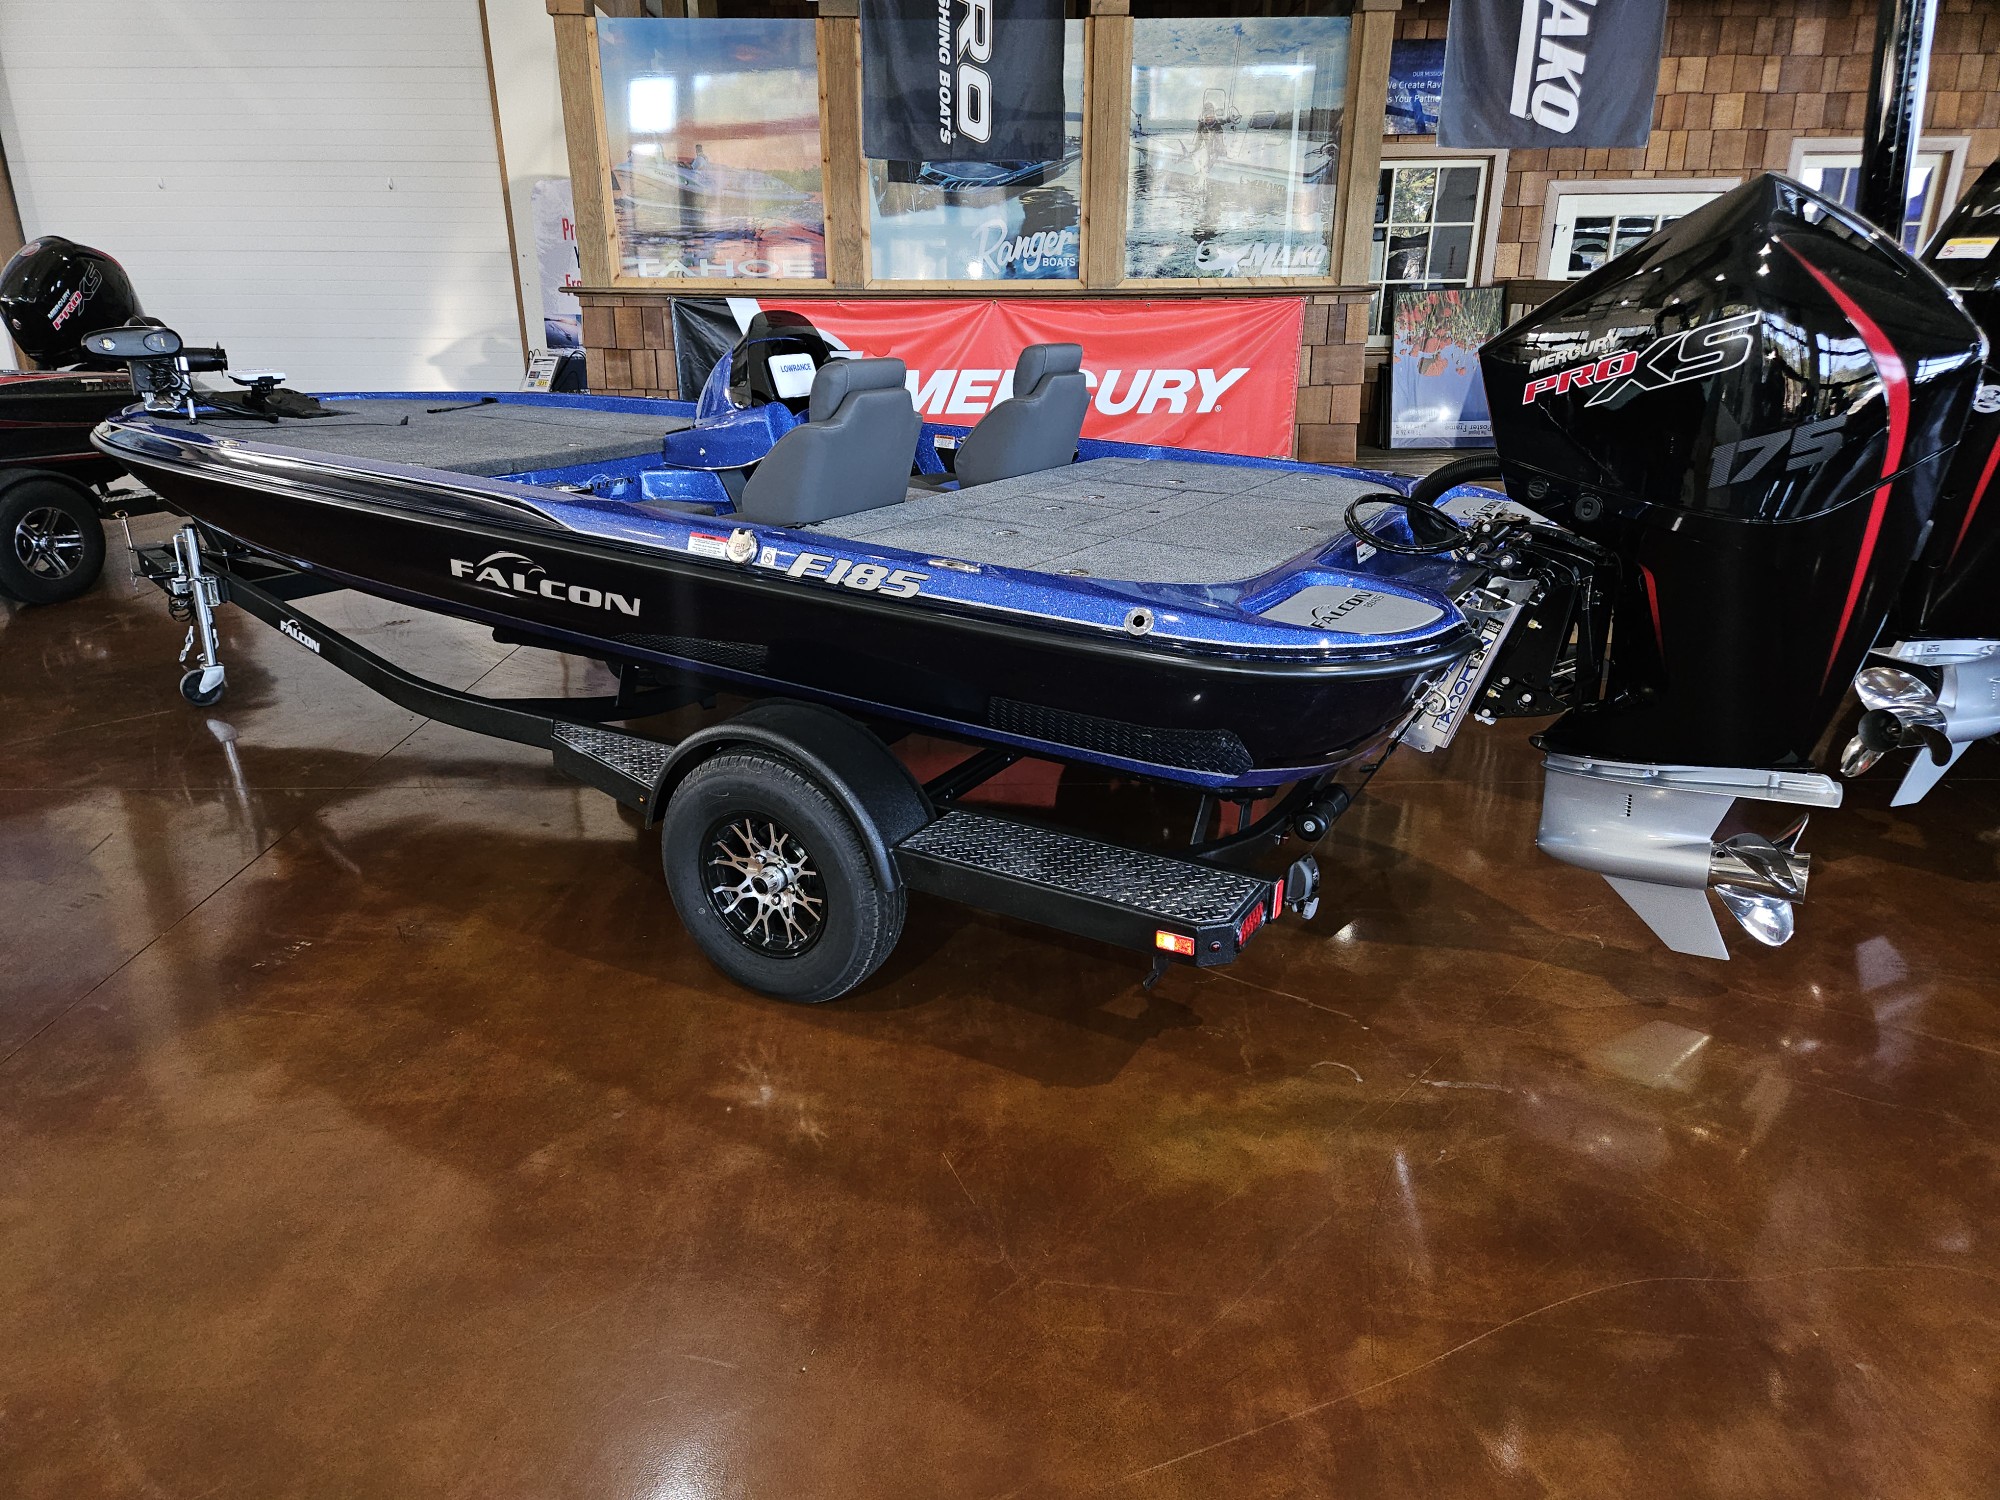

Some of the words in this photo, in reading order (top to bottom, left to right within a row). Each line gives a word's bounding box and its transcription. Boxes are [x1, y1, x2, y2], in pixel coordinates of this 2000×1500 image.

[1399, 81, 1425, 89] Create
[1510, 0, 1597, 134] AKO
[939, 69, 951, 145] BOATS
[1395, 95, 1412, 103] Your
[562, 217, 577, 241] Pr
[971, 219, 1079, 274] Ranger
[625, 257, 815, 277] TAHOE
[1042, 257, 1076, 267] BOATS
[1238, 242, 1328, 275] MAKO
[48, 289, 71, 320] MERCURY
[52, 290, 83, 331] PRO
[780, 363, 812, 373] LOWRANCE
[1522, 350, 1640, 406] PRO
[1584, 309, 1762, 408] XS
[1529, 329, 1621, 374] MERCURY
[904, 367, 1251, 416] MEURY
[1708, 414, 1847, 490] 175
[450, 557, 641, 617] FALCON
[786, 551, 930, 599] F185
[1310, 590, 1373, 629] FALCON
[280, 620, 320, 653] FALCON
